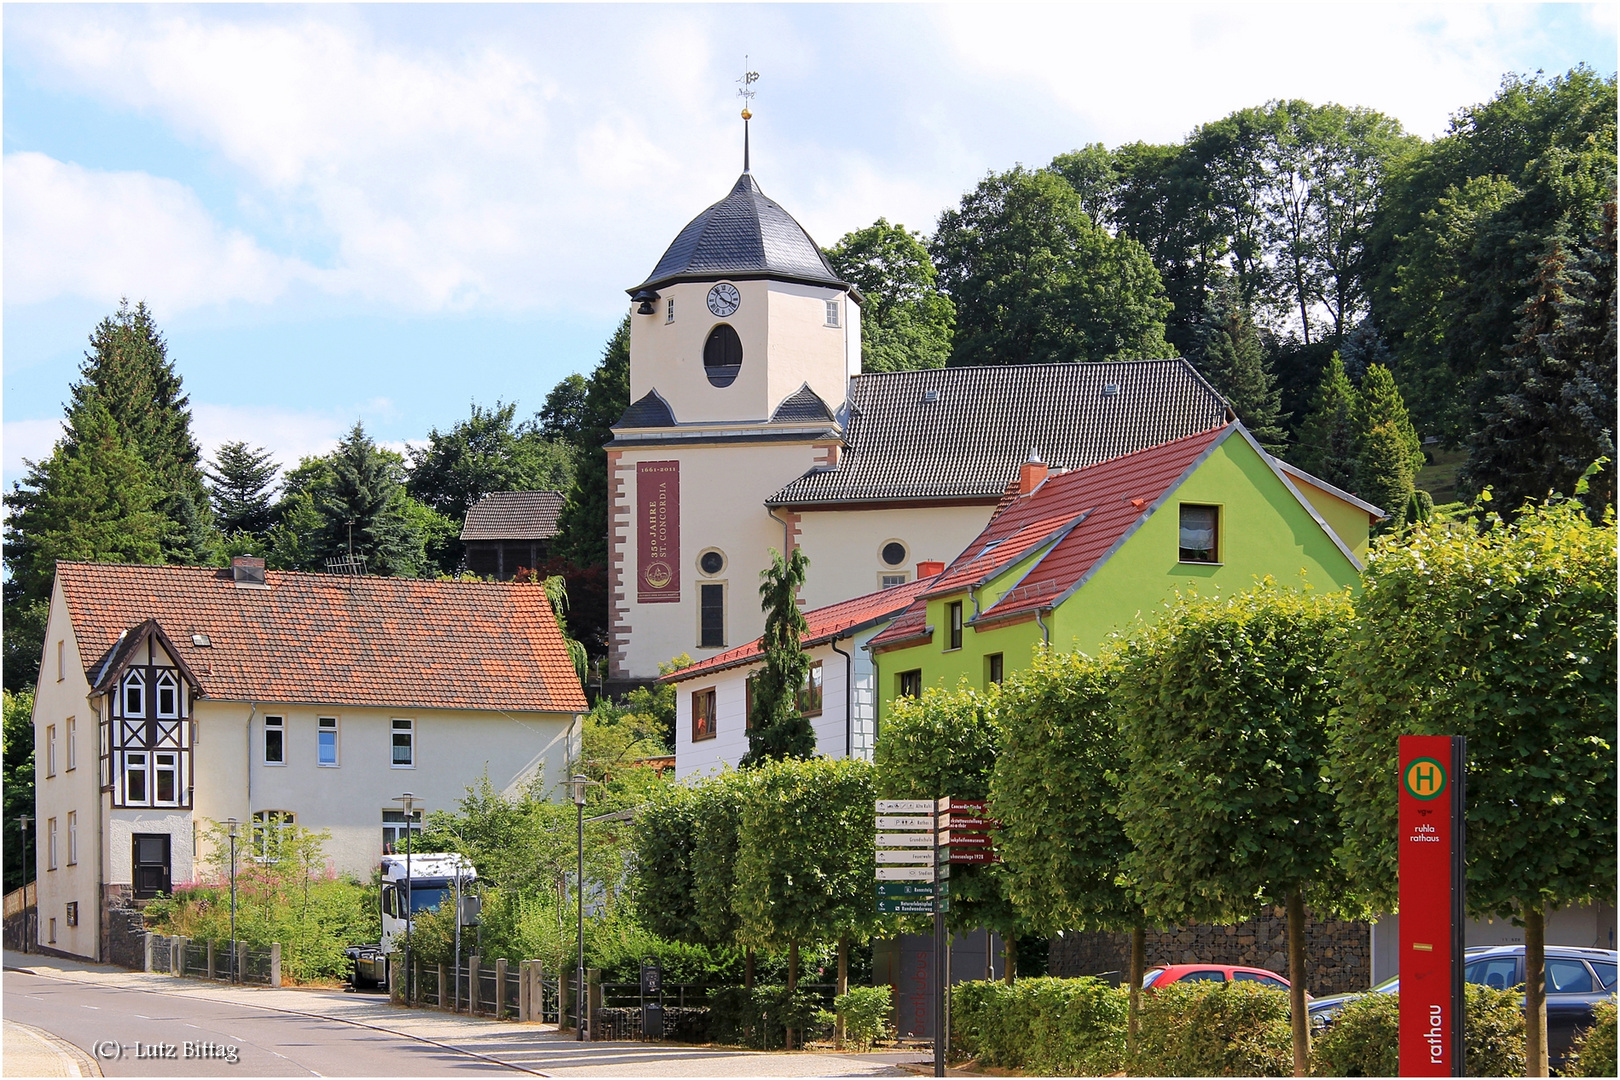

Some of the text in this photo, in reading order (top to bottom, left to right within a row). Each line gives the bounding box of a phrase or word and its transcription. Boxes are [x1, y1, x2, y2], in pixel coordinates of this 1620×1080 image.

[649, 501, 657, 537] JAHRE
[659, 482, 667, 558] ST. CONCORDIA
[1416, 766, 1434, 791] H
[1410, 833, 1440, 842] rathaus
[1414, 823, 1435, 833] ruhla
[910, 951, 927, 1035] bratkubus
[1423, 1004, 1443, 1064] rathau
